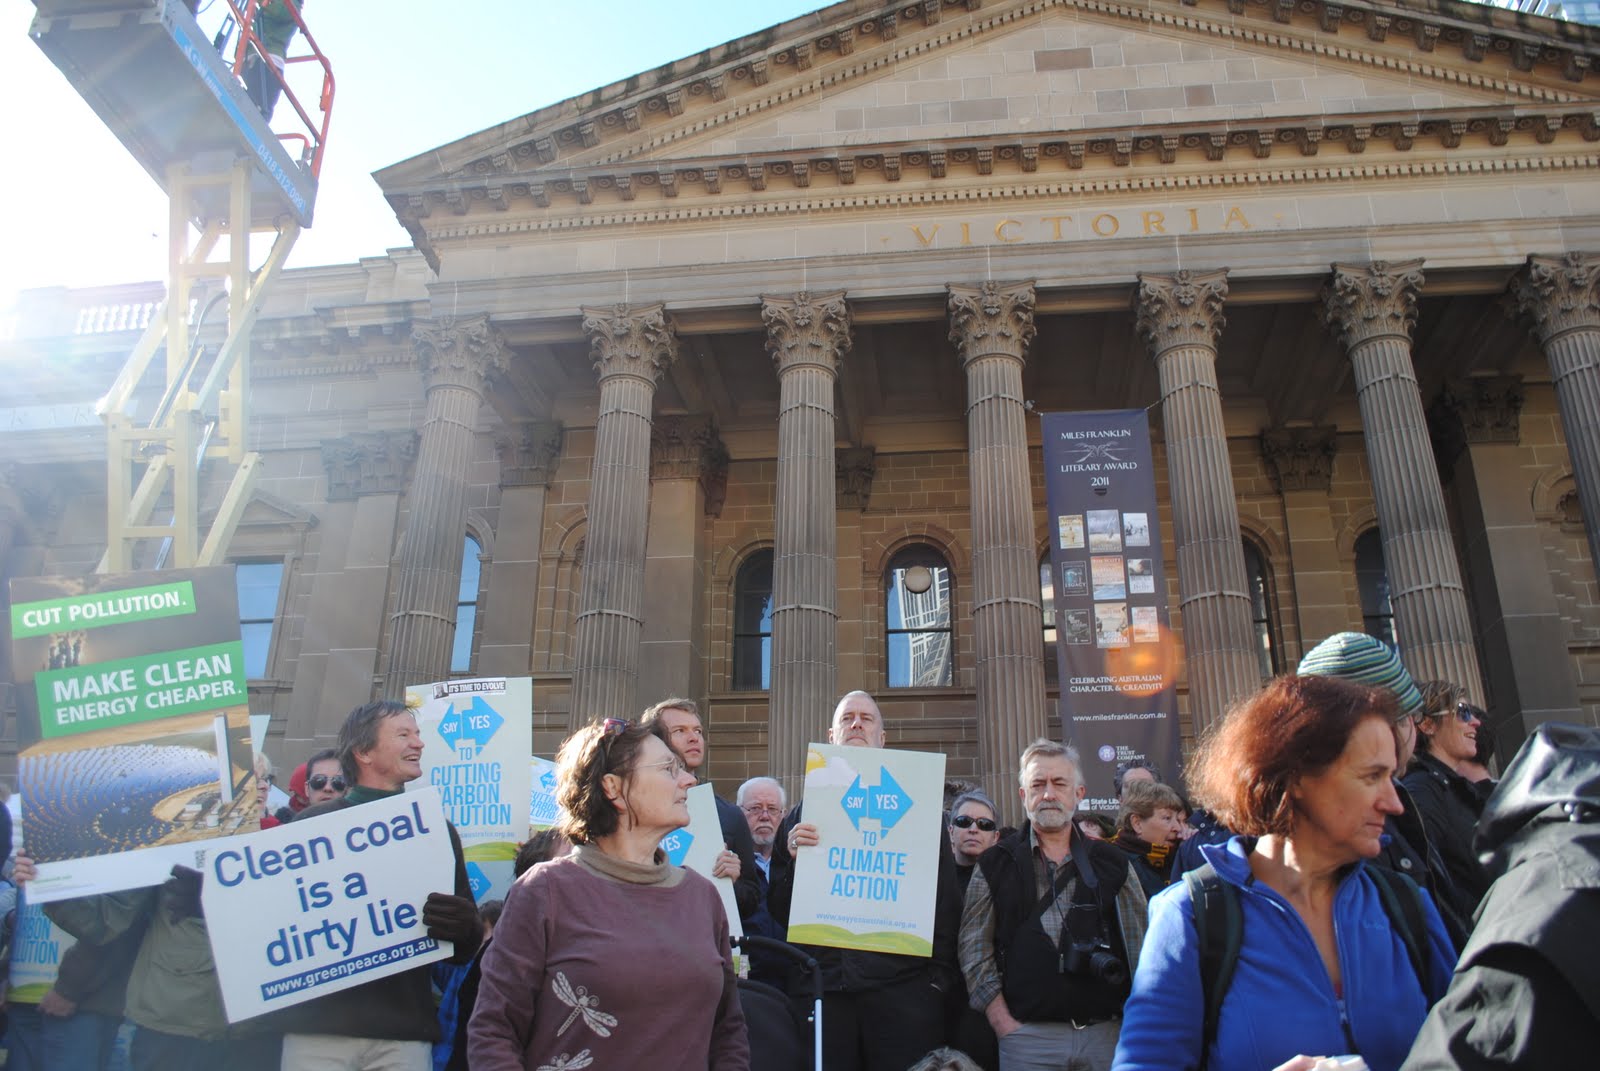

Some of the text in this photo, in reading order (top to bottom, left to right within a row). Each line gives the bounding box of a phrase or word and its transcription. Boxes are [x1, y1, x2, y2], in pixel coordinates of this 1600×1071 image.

[258, 144, 278, 172] 0418
[910, 206, 1253, 247] VICTORIA
[1061, 429, 1131, 440] MILES FRANKLIN
[1061, 461, 1137, 473] LITERARY AWARD
[1091, 476, 1110, 487] 2011
[22, 591, 187, 628] CUT POLLUTION.
[53, 653, 233, 703] MAKE CLEAN
[460, 683, 473, 692] TIME
[473, 682, 481, 691] TO
[481, 681, 505, 691] EVOLVE
[1070, 674, 1162, 685] CELEBRATING AUSTRALIAN
[1070, 682, 1163, 693] CHARACTER & CREATIVITY
[56, 679, 242, 725] ENERGY CHEAPER.
[443, 715, 490, 734] SAY YES
[1072, 712, 1167, 722] www.milesfranklin.com.au
[458, 746, 472, 761] TO
[431, 762, 502, 786] CUTTING
[437, 783, 500, 806] ARBON
[847, 794, 898, 810] SAY YES
[214, 801, 431, 887] Clean coal
[863, 831, 877, 846] TO
[828, 846, 908, 876] CLIMATE
[295, 872, 368, 913] is a
[831, 873, 899, 902] ACTION
[266, 899, 418, 968] dirty lie
[264, 939, 435, 997] www.greenpeace.org.au
